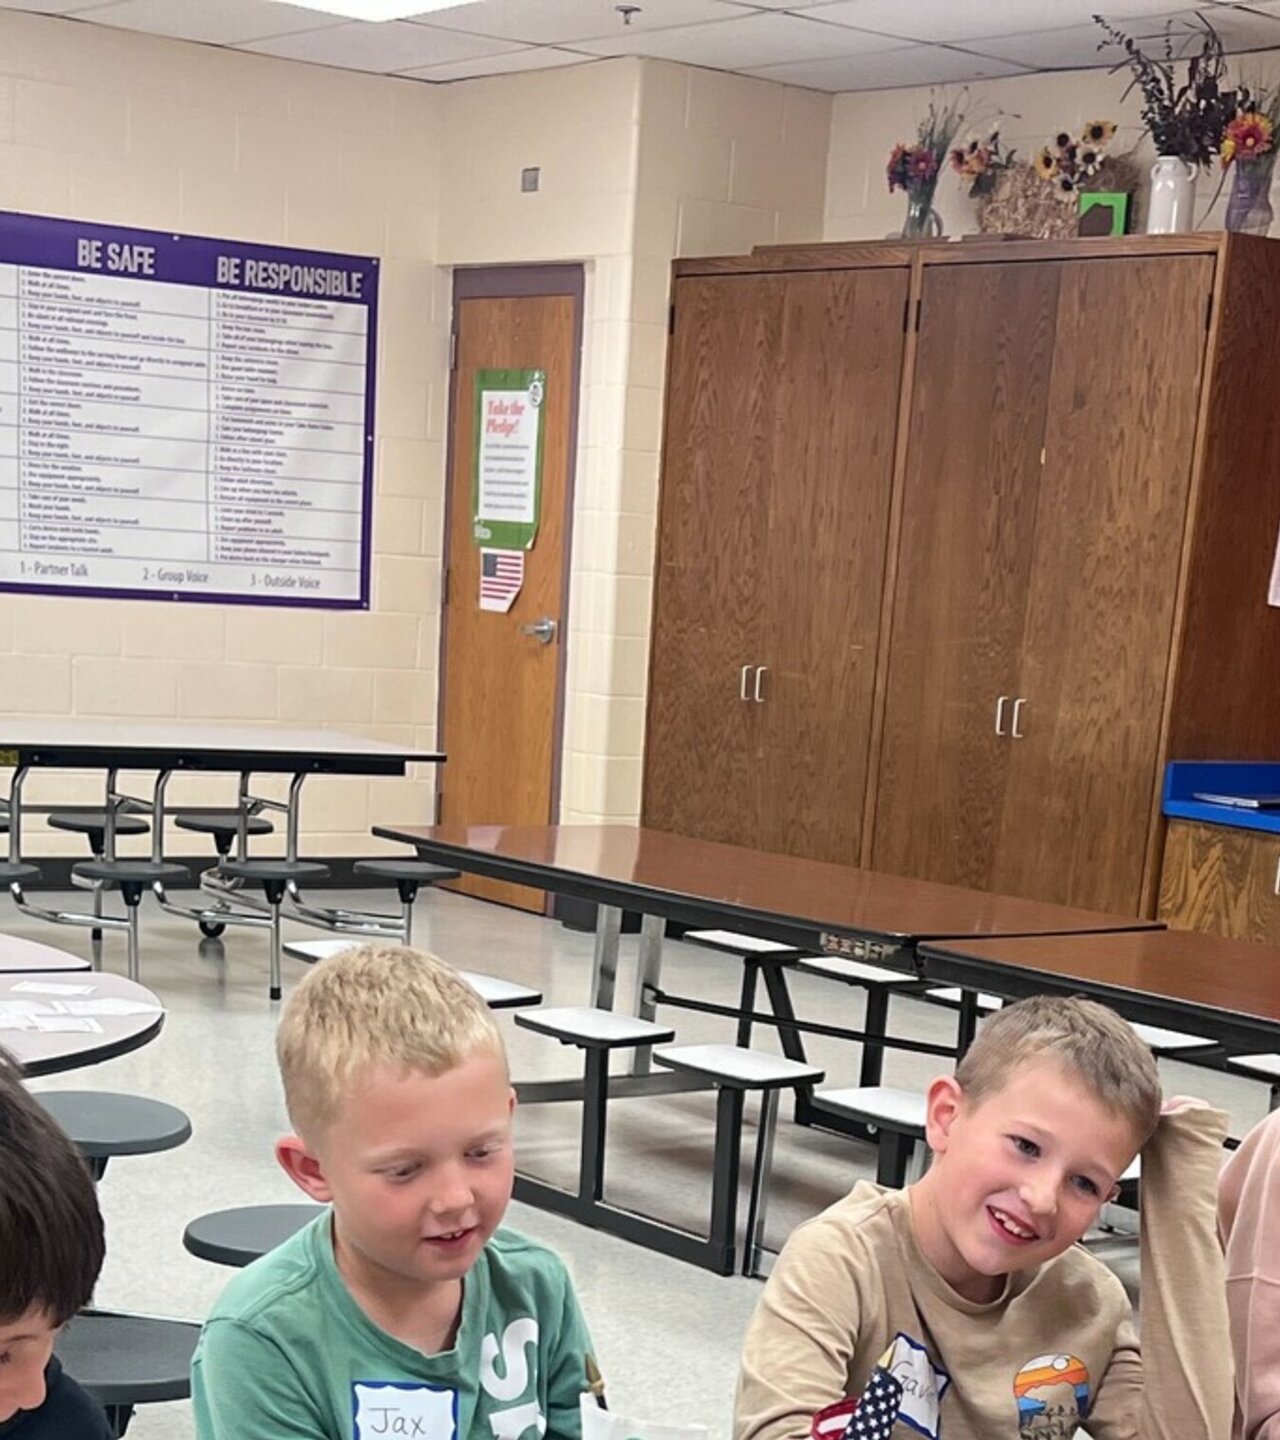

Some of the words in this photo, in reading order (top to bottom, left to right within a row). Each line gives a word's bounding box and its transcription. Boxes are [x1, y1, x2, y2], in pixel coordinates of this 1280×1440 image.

[77, 239, 102, 269] BE
[107, 243, 155, 275] SAFE
[217, 256, 239, 284] BE
[245, 259, 363, 298] RESPONSIBLE
[34, 561, 67, 577] Partner
[70, 562, 89, 577] Talk
[143, 568, 150, 581] 2
[157, 569, 184, 584] Group
[187, 570, 209, 584] Voice
[263, 573, 296, 588] Outside
[299, 575, 320, 589] Voice
[368, 1406, 426, 1436] Jax
